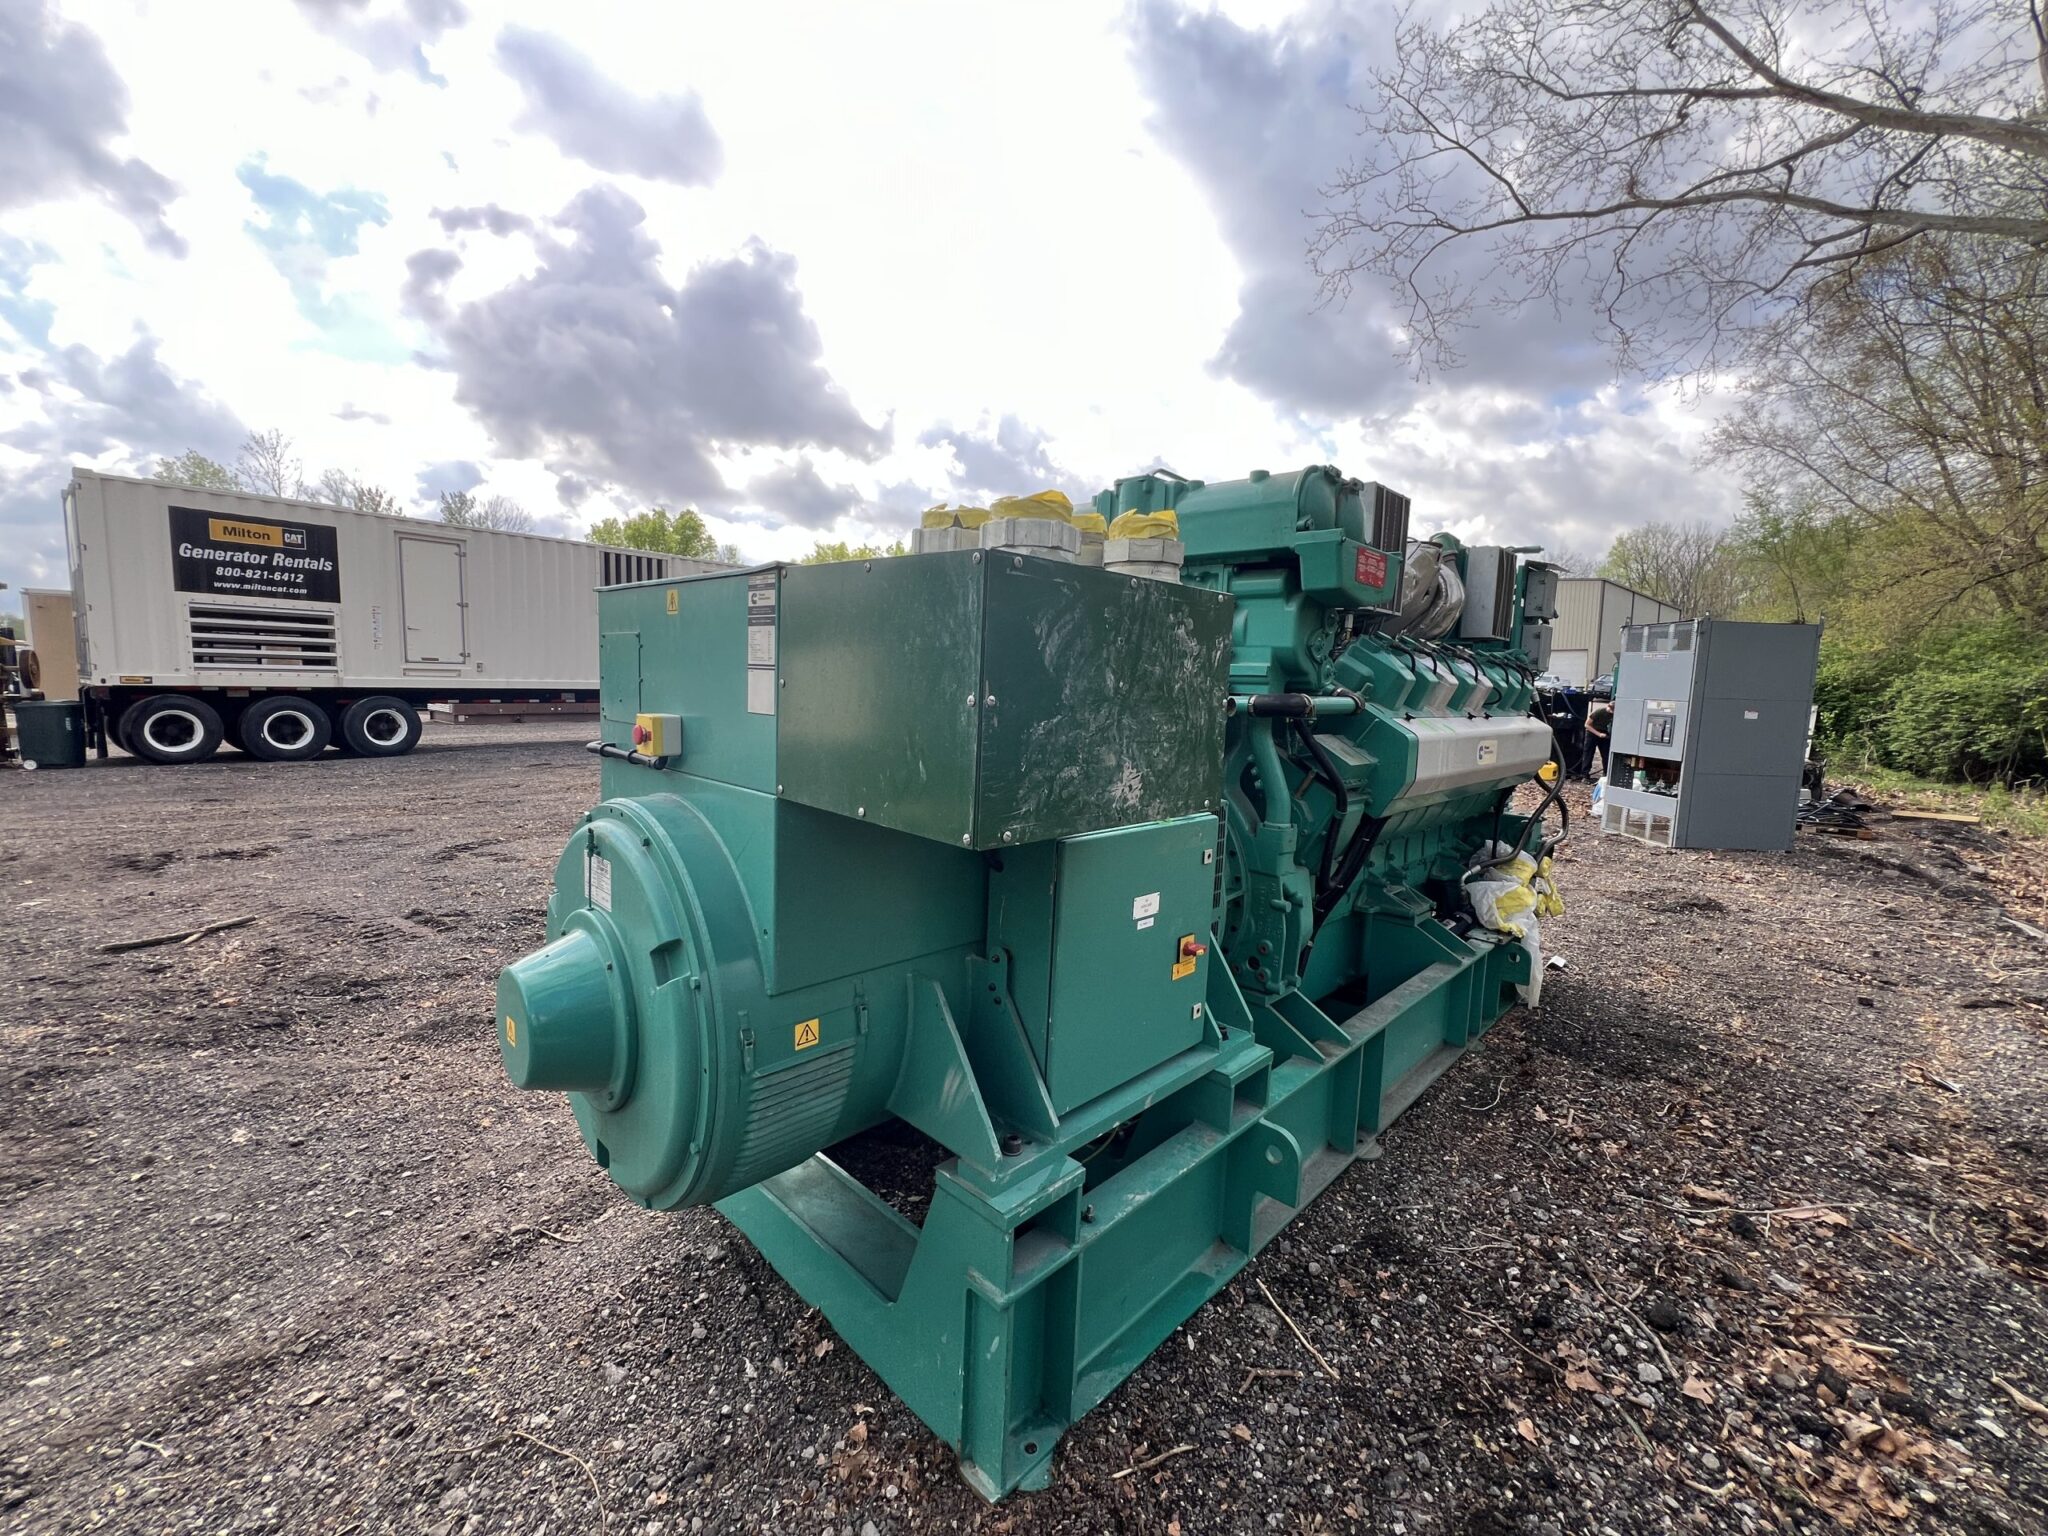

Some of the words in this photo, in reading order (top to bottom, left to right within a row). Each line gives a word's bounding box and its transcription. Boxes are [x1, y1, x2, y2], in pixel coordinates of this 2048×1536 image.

[222, 525, 271, 541] Milton
[284, 532, 304, 544] CAT
[179, 542, 268, 565] Generator
[272, 553, 333, 572] Rentals
[215, 566, 305, 583] 800-821-6412
[213, 581, 308, 595] www.miltoncat.com
